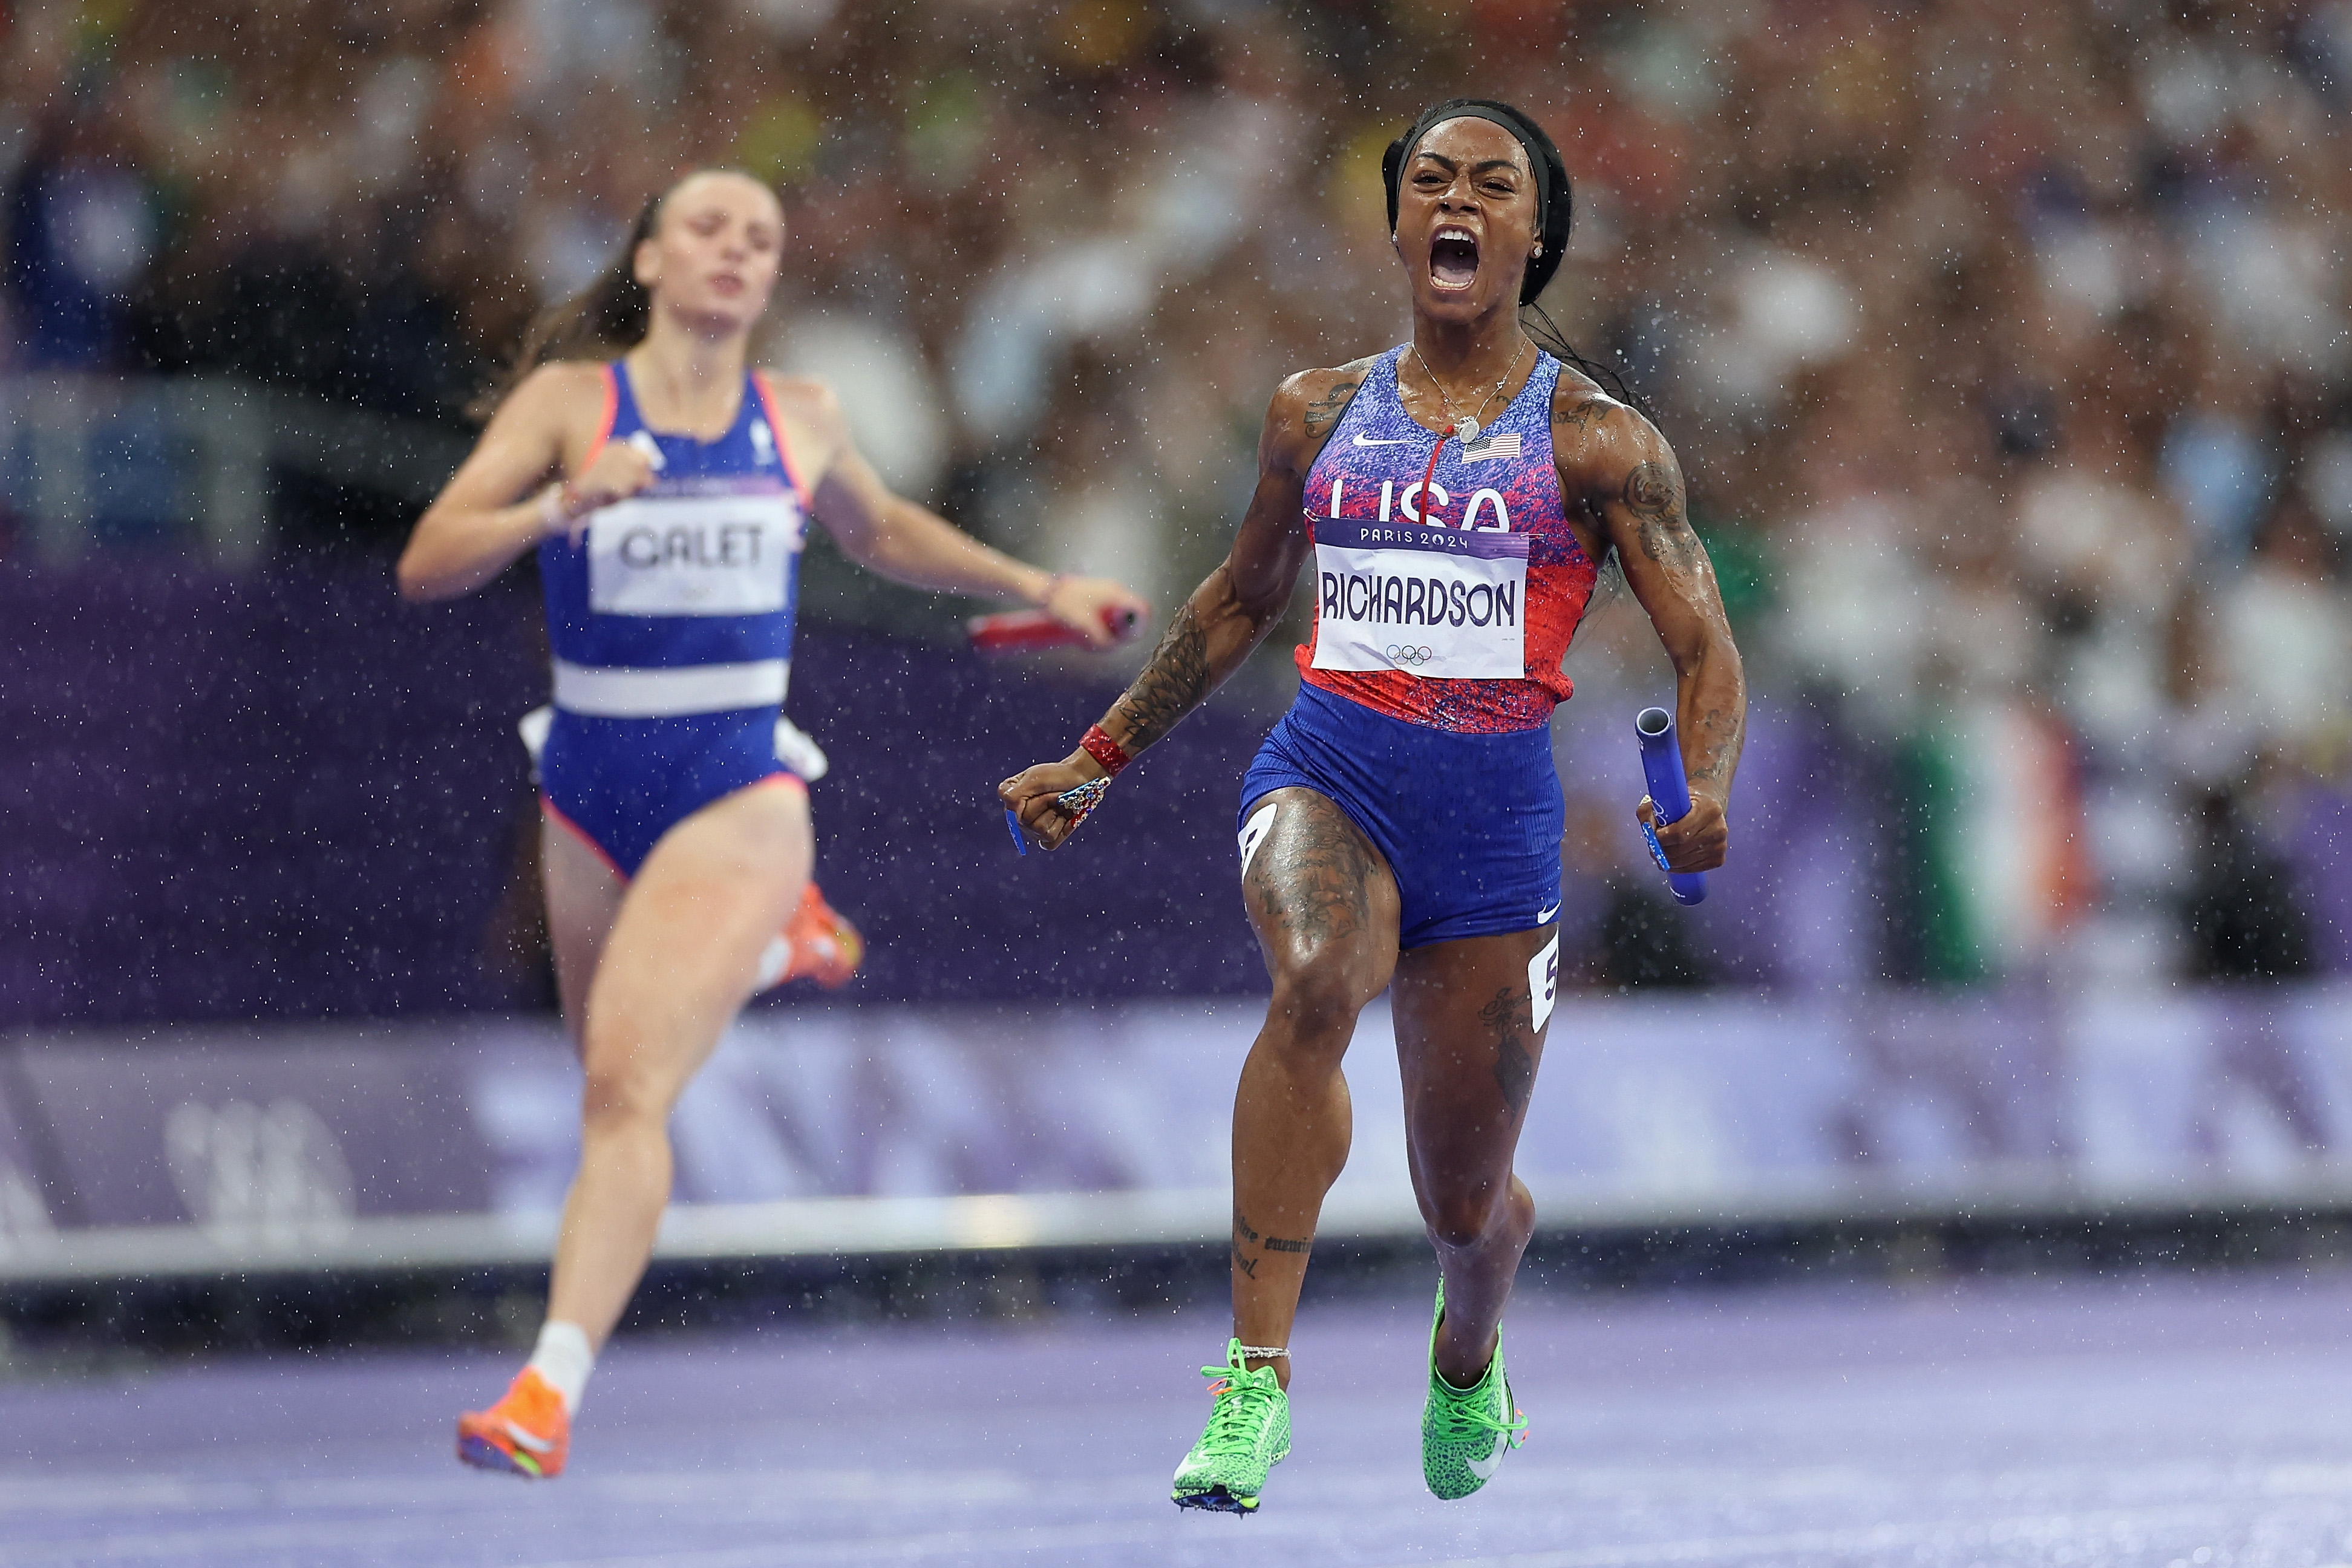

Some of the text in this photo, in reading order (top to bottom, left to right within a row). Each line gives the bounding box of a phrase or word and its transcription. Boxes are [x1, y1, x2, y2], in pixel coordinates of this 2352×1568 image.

[1420, 532, 1468, 549] 2024
[1322, 571, 1515, 627] RICHARDSON
[1545, 947, 1558, 1001] 5
